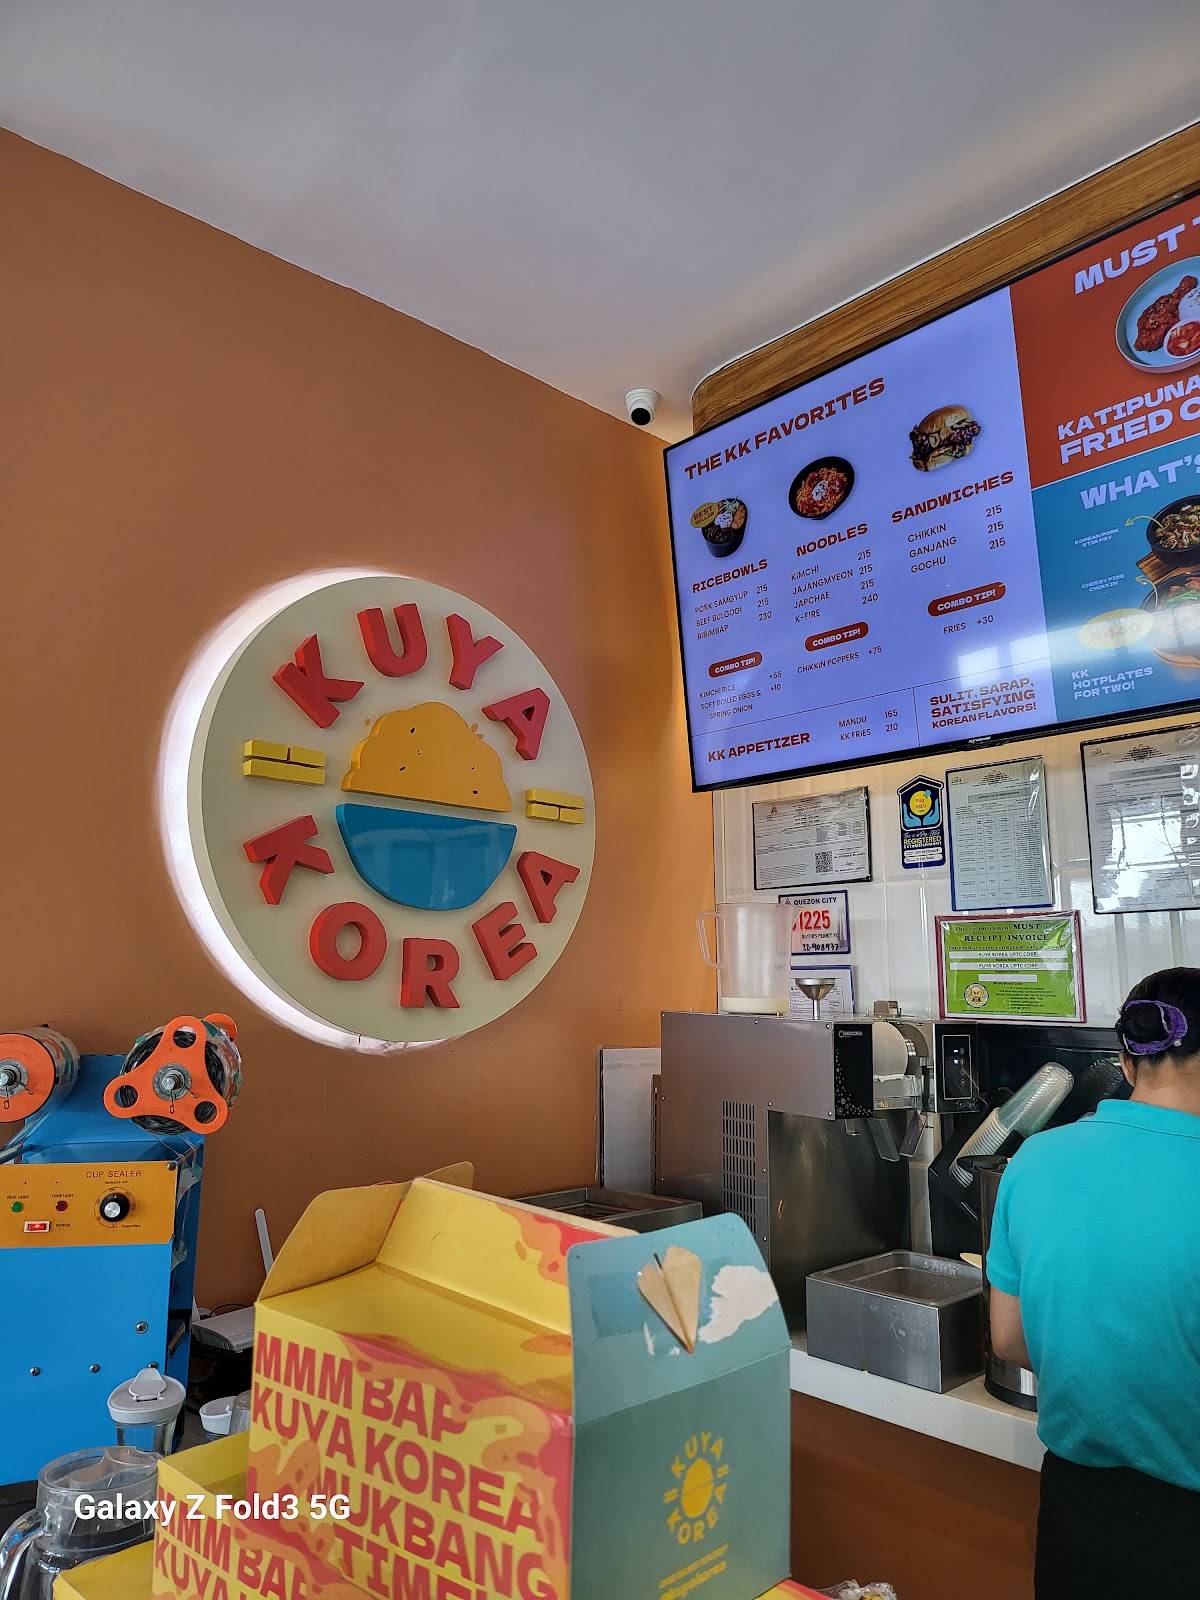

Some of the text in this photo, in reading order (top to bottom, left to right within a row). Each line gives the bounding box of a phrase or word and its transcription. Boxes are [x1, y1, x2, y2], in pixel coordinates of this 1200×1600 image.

[1075, 224, 1186, 295] MUST
[684, 377, 885, 480] THE KK FAVORITES
[1060, 408, 1173, 465] FRIED
[1079, 453, 1200, 510] WHAT'
[891, 471, 1014, 523] SANDWICHES
[693, 505, 713, 521] BEST
[907, 505, 1003, 543] CHIKKIN 215
[796, 523, 868, 557] NOODLES
[909, 521, 1004, 558] GANJANG 215
[1074, 527, 1119, 544] KOREAN PORK
[1082, 535, 1113, 548] STIR FRY
[791, 550, 872, 582] KIMCHI 215
[910, 538, 1006, 573] GOCHU 215
[692, 559, 768, 593] RICEBOWLS
[792, 564, 873, 595] JAJANGMYEON 215
[694, 584, 768, 613] PORK SAMGYUP 215
[793, 579, 875, 609] JAPCHAE 215
[795, 593, 879, 623] K-FIRE 240
[937, 588, 996, 611] COMBO TIP!
[696, 598, 769, 627] BEEF BULGOGI 215
[697, 611, 772, 640] BIBIMBAP 230
[943, 614, 994, 635] FRIES +30
[812, 627, 861, 647] COMBO TIP!
[714, 661, 740, 674] COMBO
[797, 660, 827, 674] CHIKKIN
[827, 652, 860, 668] POPPERS
[1072, 668, 1089, 680] KK
[272, 602, 551, 761] KUYA
[699, 687, 721, 699] KIMCHI
[720, 684, 736, 693] RICE
[979, 677, 1034, 696] SARAP,
[1072, 666, 1154, 690] HOTPLATES
[1074, 680, 1136, 701] FOR TWO!
[700, 700, 715, 710] SOFT
[737, 691, 755, 702] EGGS
[709, 703, 753, 720] SPRING ONION
[930, 689, 1036, 718] SATISFYING
[931, 701, 1037, 729] KOREAN FLAVORS!
[838, 709, 898, 728] MANDU 165
[840, 722, 898, 742] KK FRIES 210
[707, 732, 811, 762] KK APPETIZER
[903, 836, 942, 846] REGISTERED
[243, 814, 580, 1009] KOREA
[821, 896, 837, 904] CITY
[792, 909, 831, 930] 1225
[86, 1170, 142, 1178] CUP SEALER
[255, 1331, 353, 1410] MMM
[252, 1381, 545, 1543] KUYA KOREA
